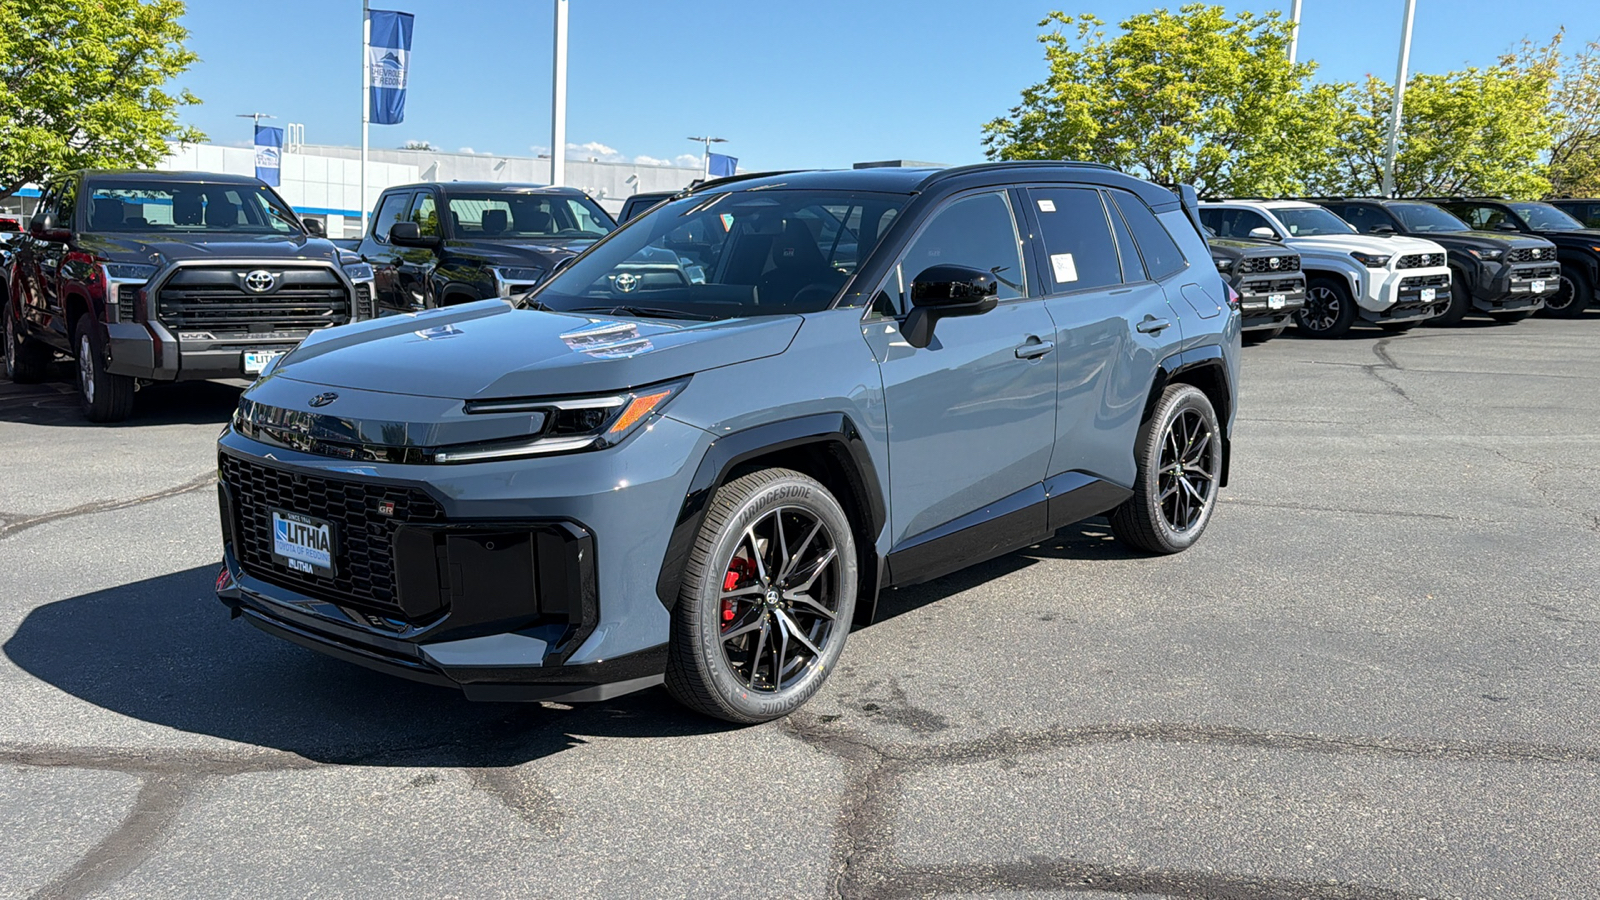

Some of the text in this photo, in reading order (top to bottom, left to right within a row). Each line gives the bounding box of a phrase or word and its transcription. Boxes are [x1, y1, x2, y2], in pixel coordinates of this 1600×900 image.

[287, 513, 300, 521] SINCE
[379, 505, 393, 515] GR
[740, 485, 812, 528] BRIDGESTONE
[276, 540, 296, 553] TOYOTA
[296, 546, 305, 554] OF
[287, 522, 330, 553] LITHIA
[294, 559, 314, 574] LITHIA
[702, 597, 719, 679] TURANZA
[759, 665, 828, 714] BRIDGESTONE
